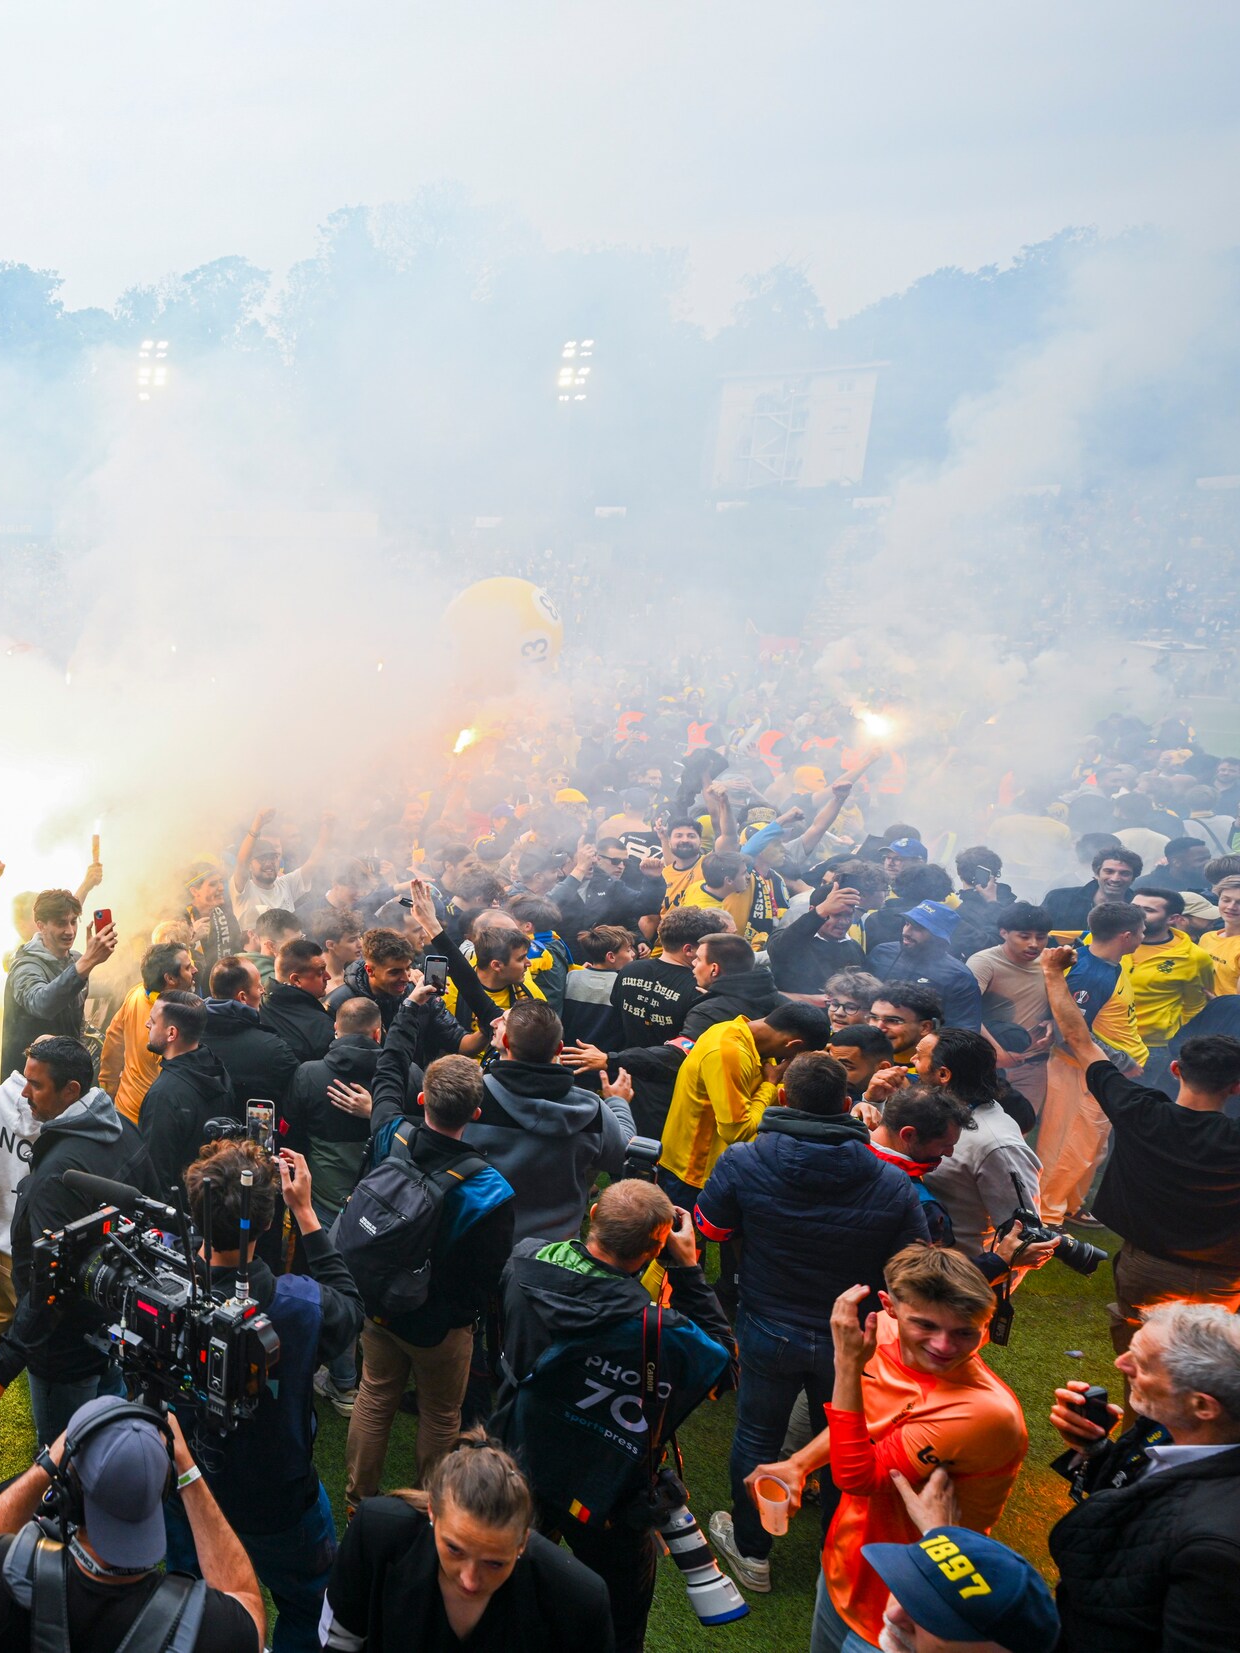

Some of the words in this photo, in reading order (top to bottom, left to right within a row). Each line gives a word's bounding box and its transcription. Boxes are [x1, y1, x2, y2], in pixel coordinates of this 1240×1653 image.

[521, 638, 548, 663] 13
[621, 976, 653, 992] away
[653, 980, 680, 1001] days
[622, 999, 646, 1018] best
[585, 1356, 672, 1399] PHOO
[647, 1362, 656, 1392] Canon
[575, 1378, 648, 1433] 70
[919, 1535, 992, 1599] 1897
